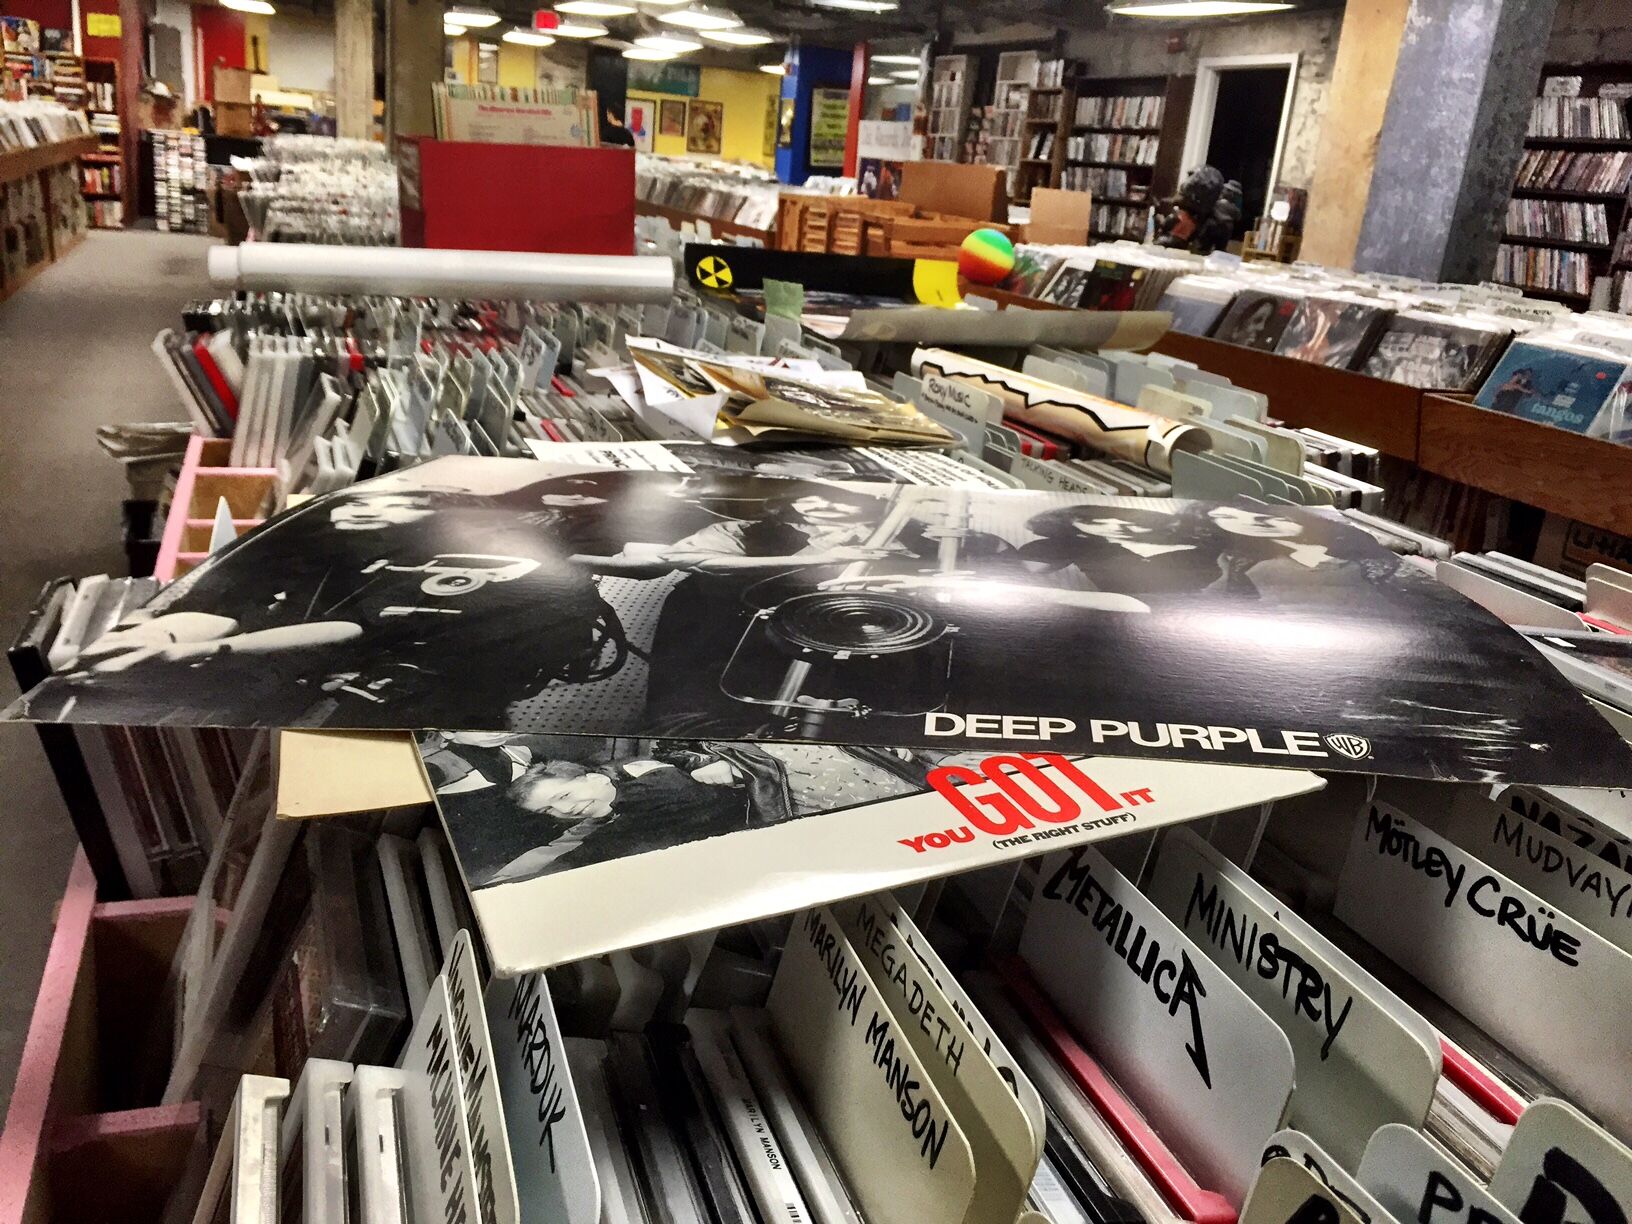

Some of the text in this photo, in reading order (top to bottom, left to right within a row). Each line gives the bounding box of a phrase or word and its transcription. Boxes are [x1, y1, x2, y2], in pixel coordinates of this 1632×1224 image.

[898, 752, 1156, 853] YOU GOT IT
[924, 712, 1077, 741] DEEP
[1090, 719, 1329, 758] PURPLE
[993, 811, 1137, 850] (THE RIGHT STUFF)
[1493, 813, 1632, 918] MUDVAY
[856, 902, 965, 1078] MEGADETH
[1042, 848, 1211, 1089] METALLICA
[1183, 871, 1354, 1062] MINISTRY
[1467, 875, 1581, 967] CRÜE
[425, 1013, 463, 1195] MACHINE
[507, 973, 567, 1174] MARDUK
[803, 908, 950, 1170] MARILYN MANSON
[742, 1100, 783, 1171] MARILYN MANSON
